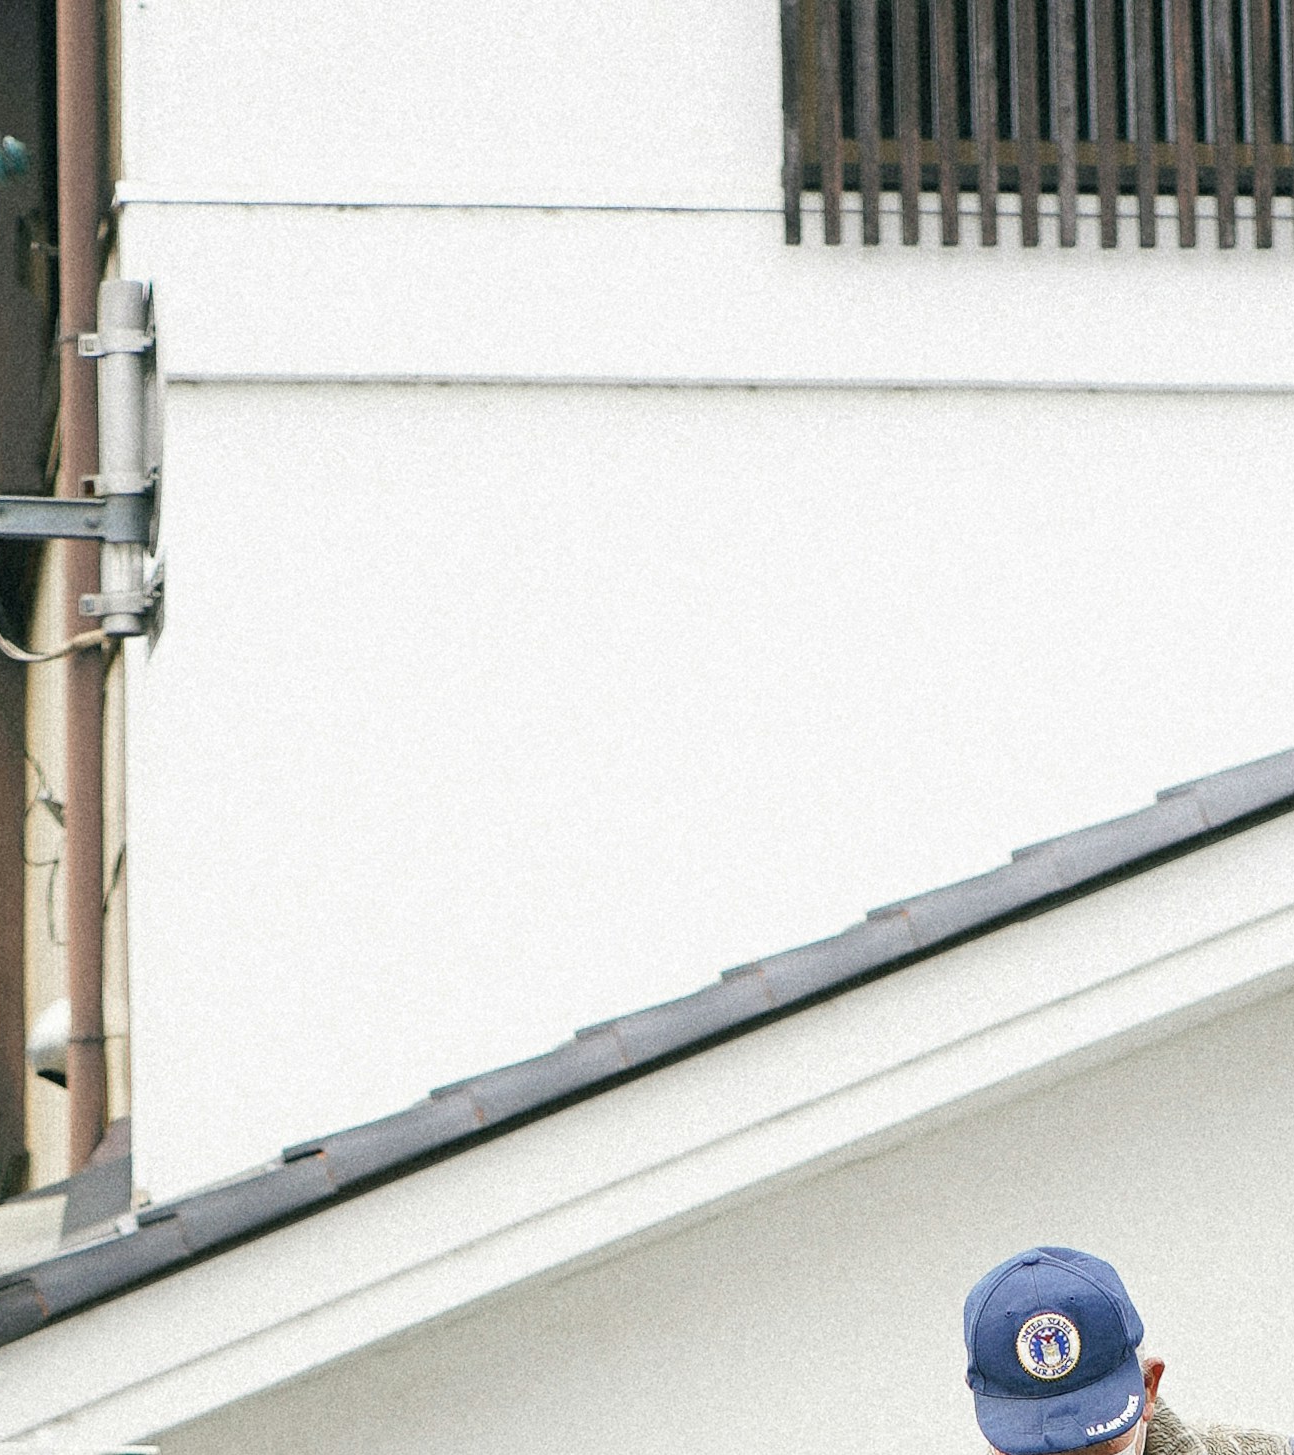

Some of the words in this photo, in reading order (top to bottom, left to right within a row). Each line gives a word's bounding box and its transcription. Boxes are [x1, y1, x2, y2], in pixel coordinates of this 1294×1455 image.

[1021, 1320, 1043, 1343] UNITED
[1048, 1318, 1073, 1335] STATES
[1033, 1366, 1048, 1376] AIR
